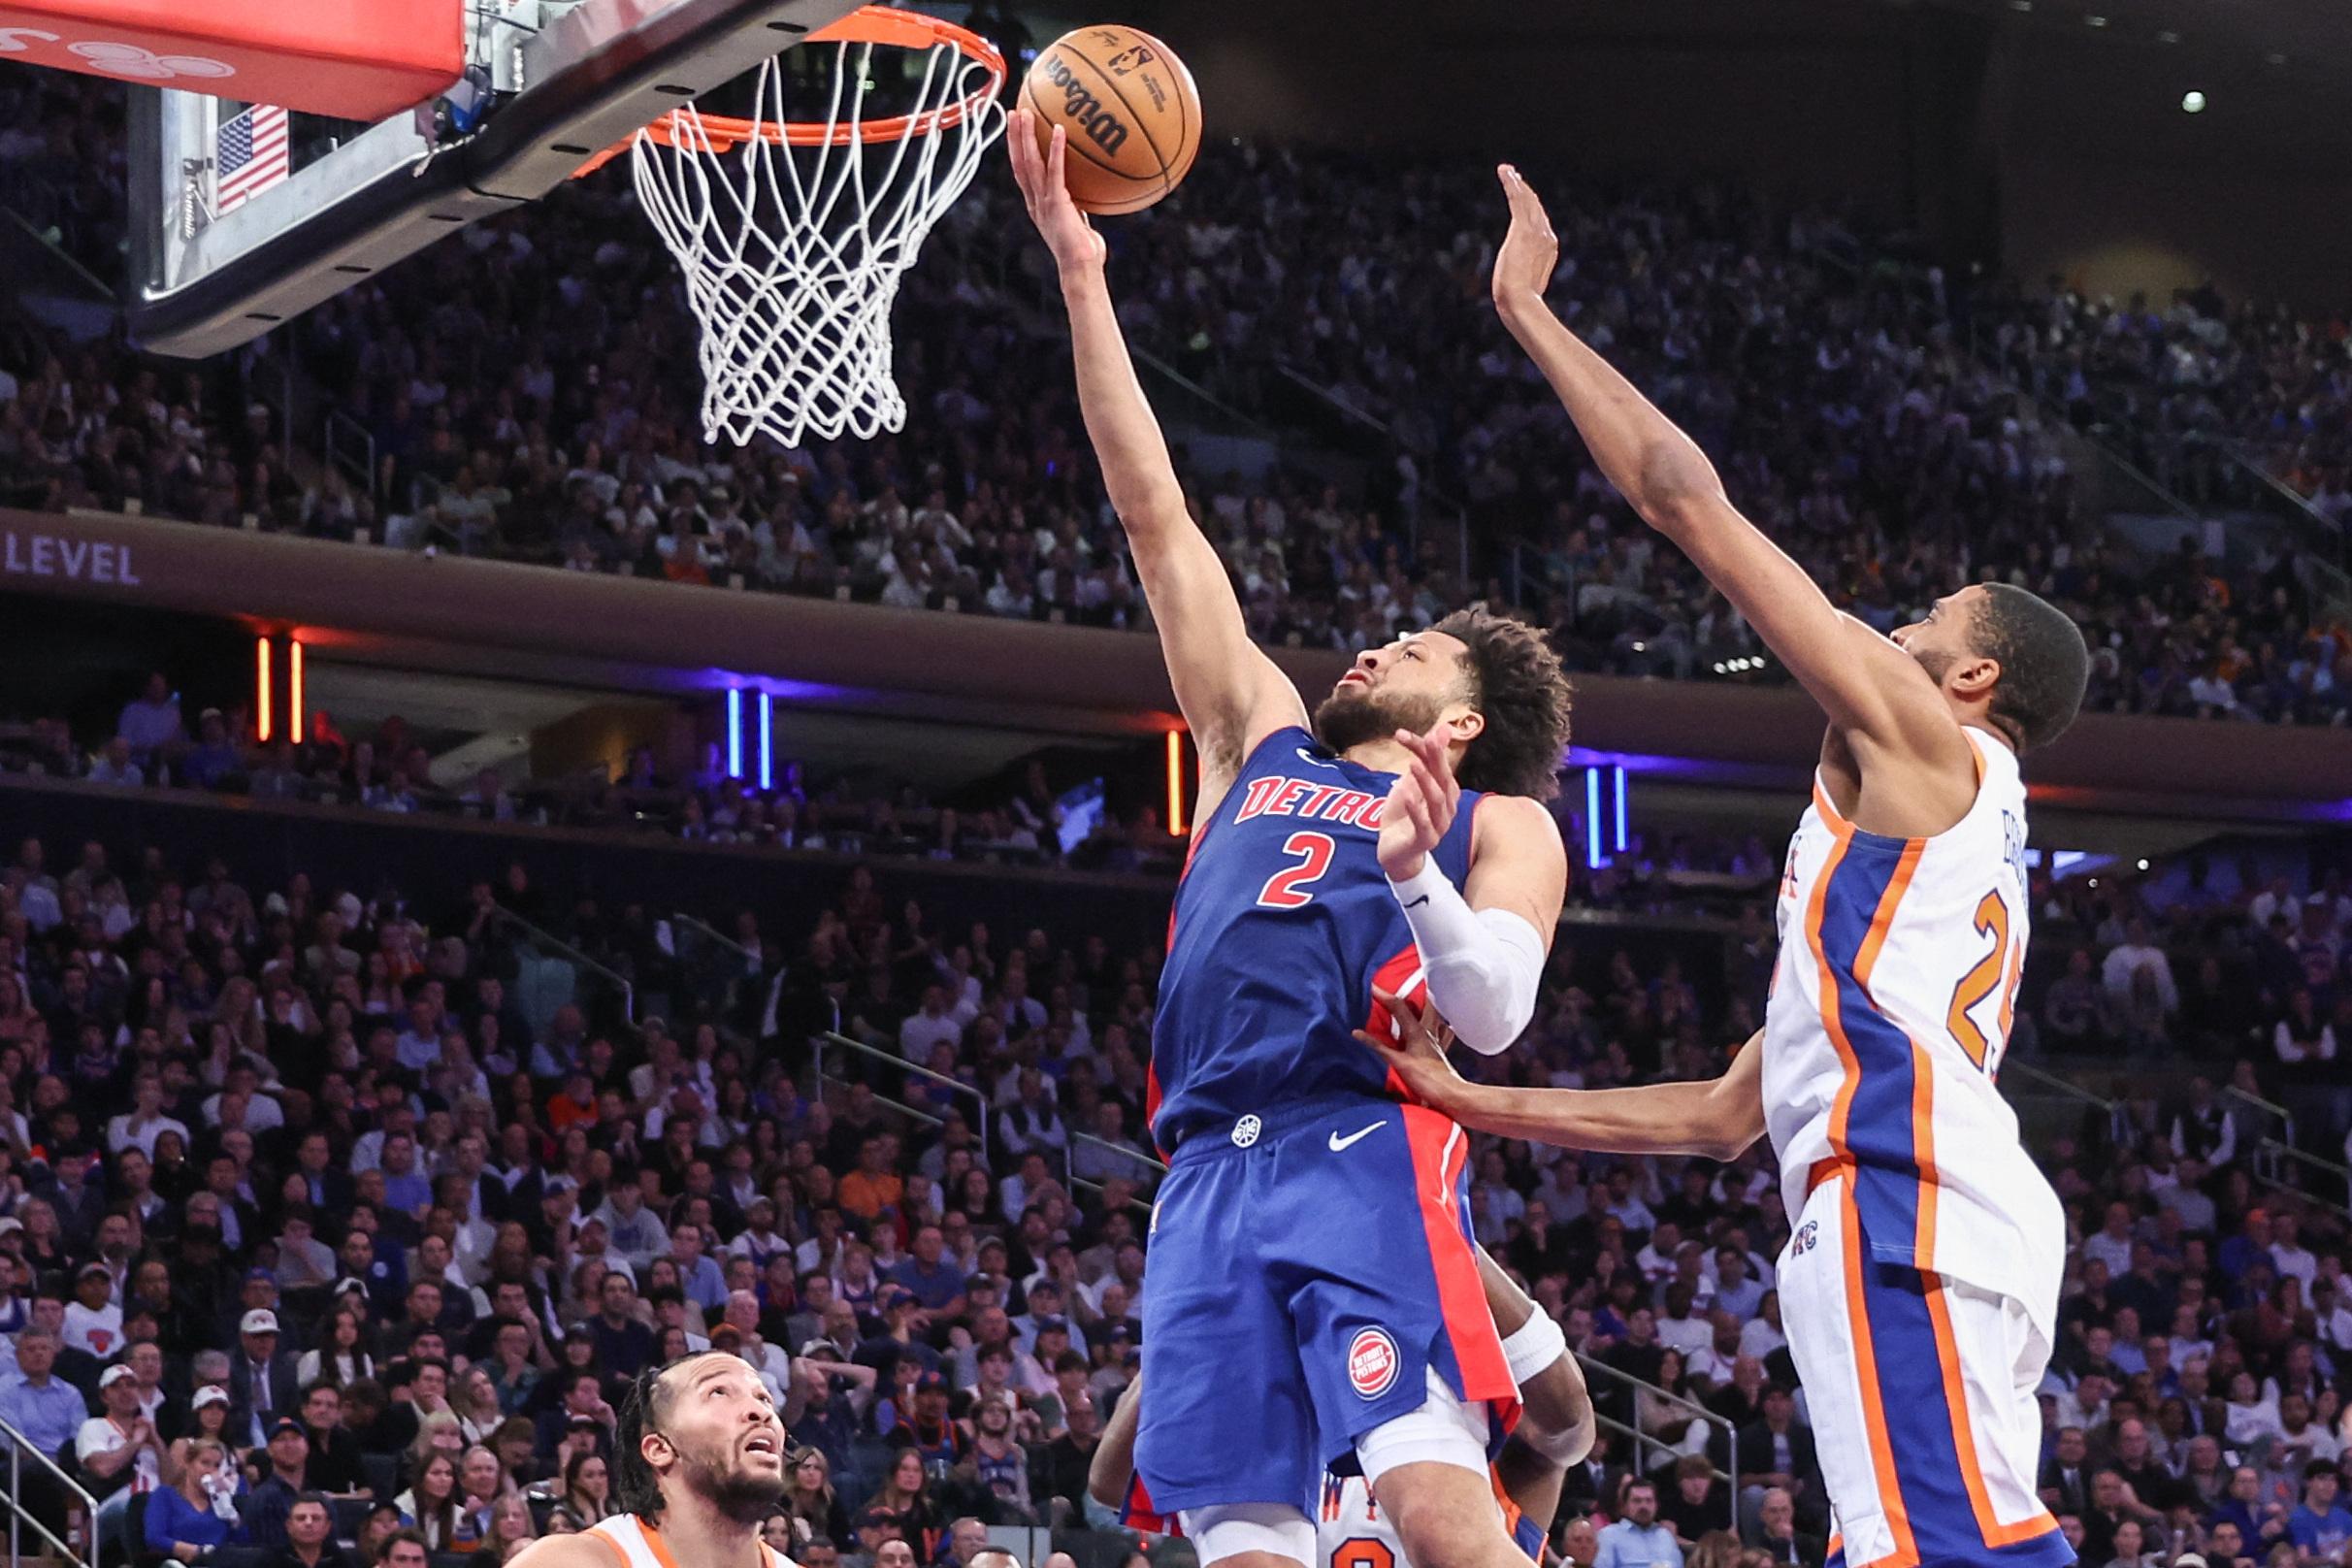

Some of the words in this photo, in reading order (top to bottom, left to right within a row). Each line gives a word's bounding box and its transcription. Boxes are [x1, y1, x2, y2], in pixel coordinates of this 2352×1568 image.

[5, 532, 141, 585] LEVEL
[1234, 776, 1386, 832] DETRO
[1257, 832, 1336, 909] 2
